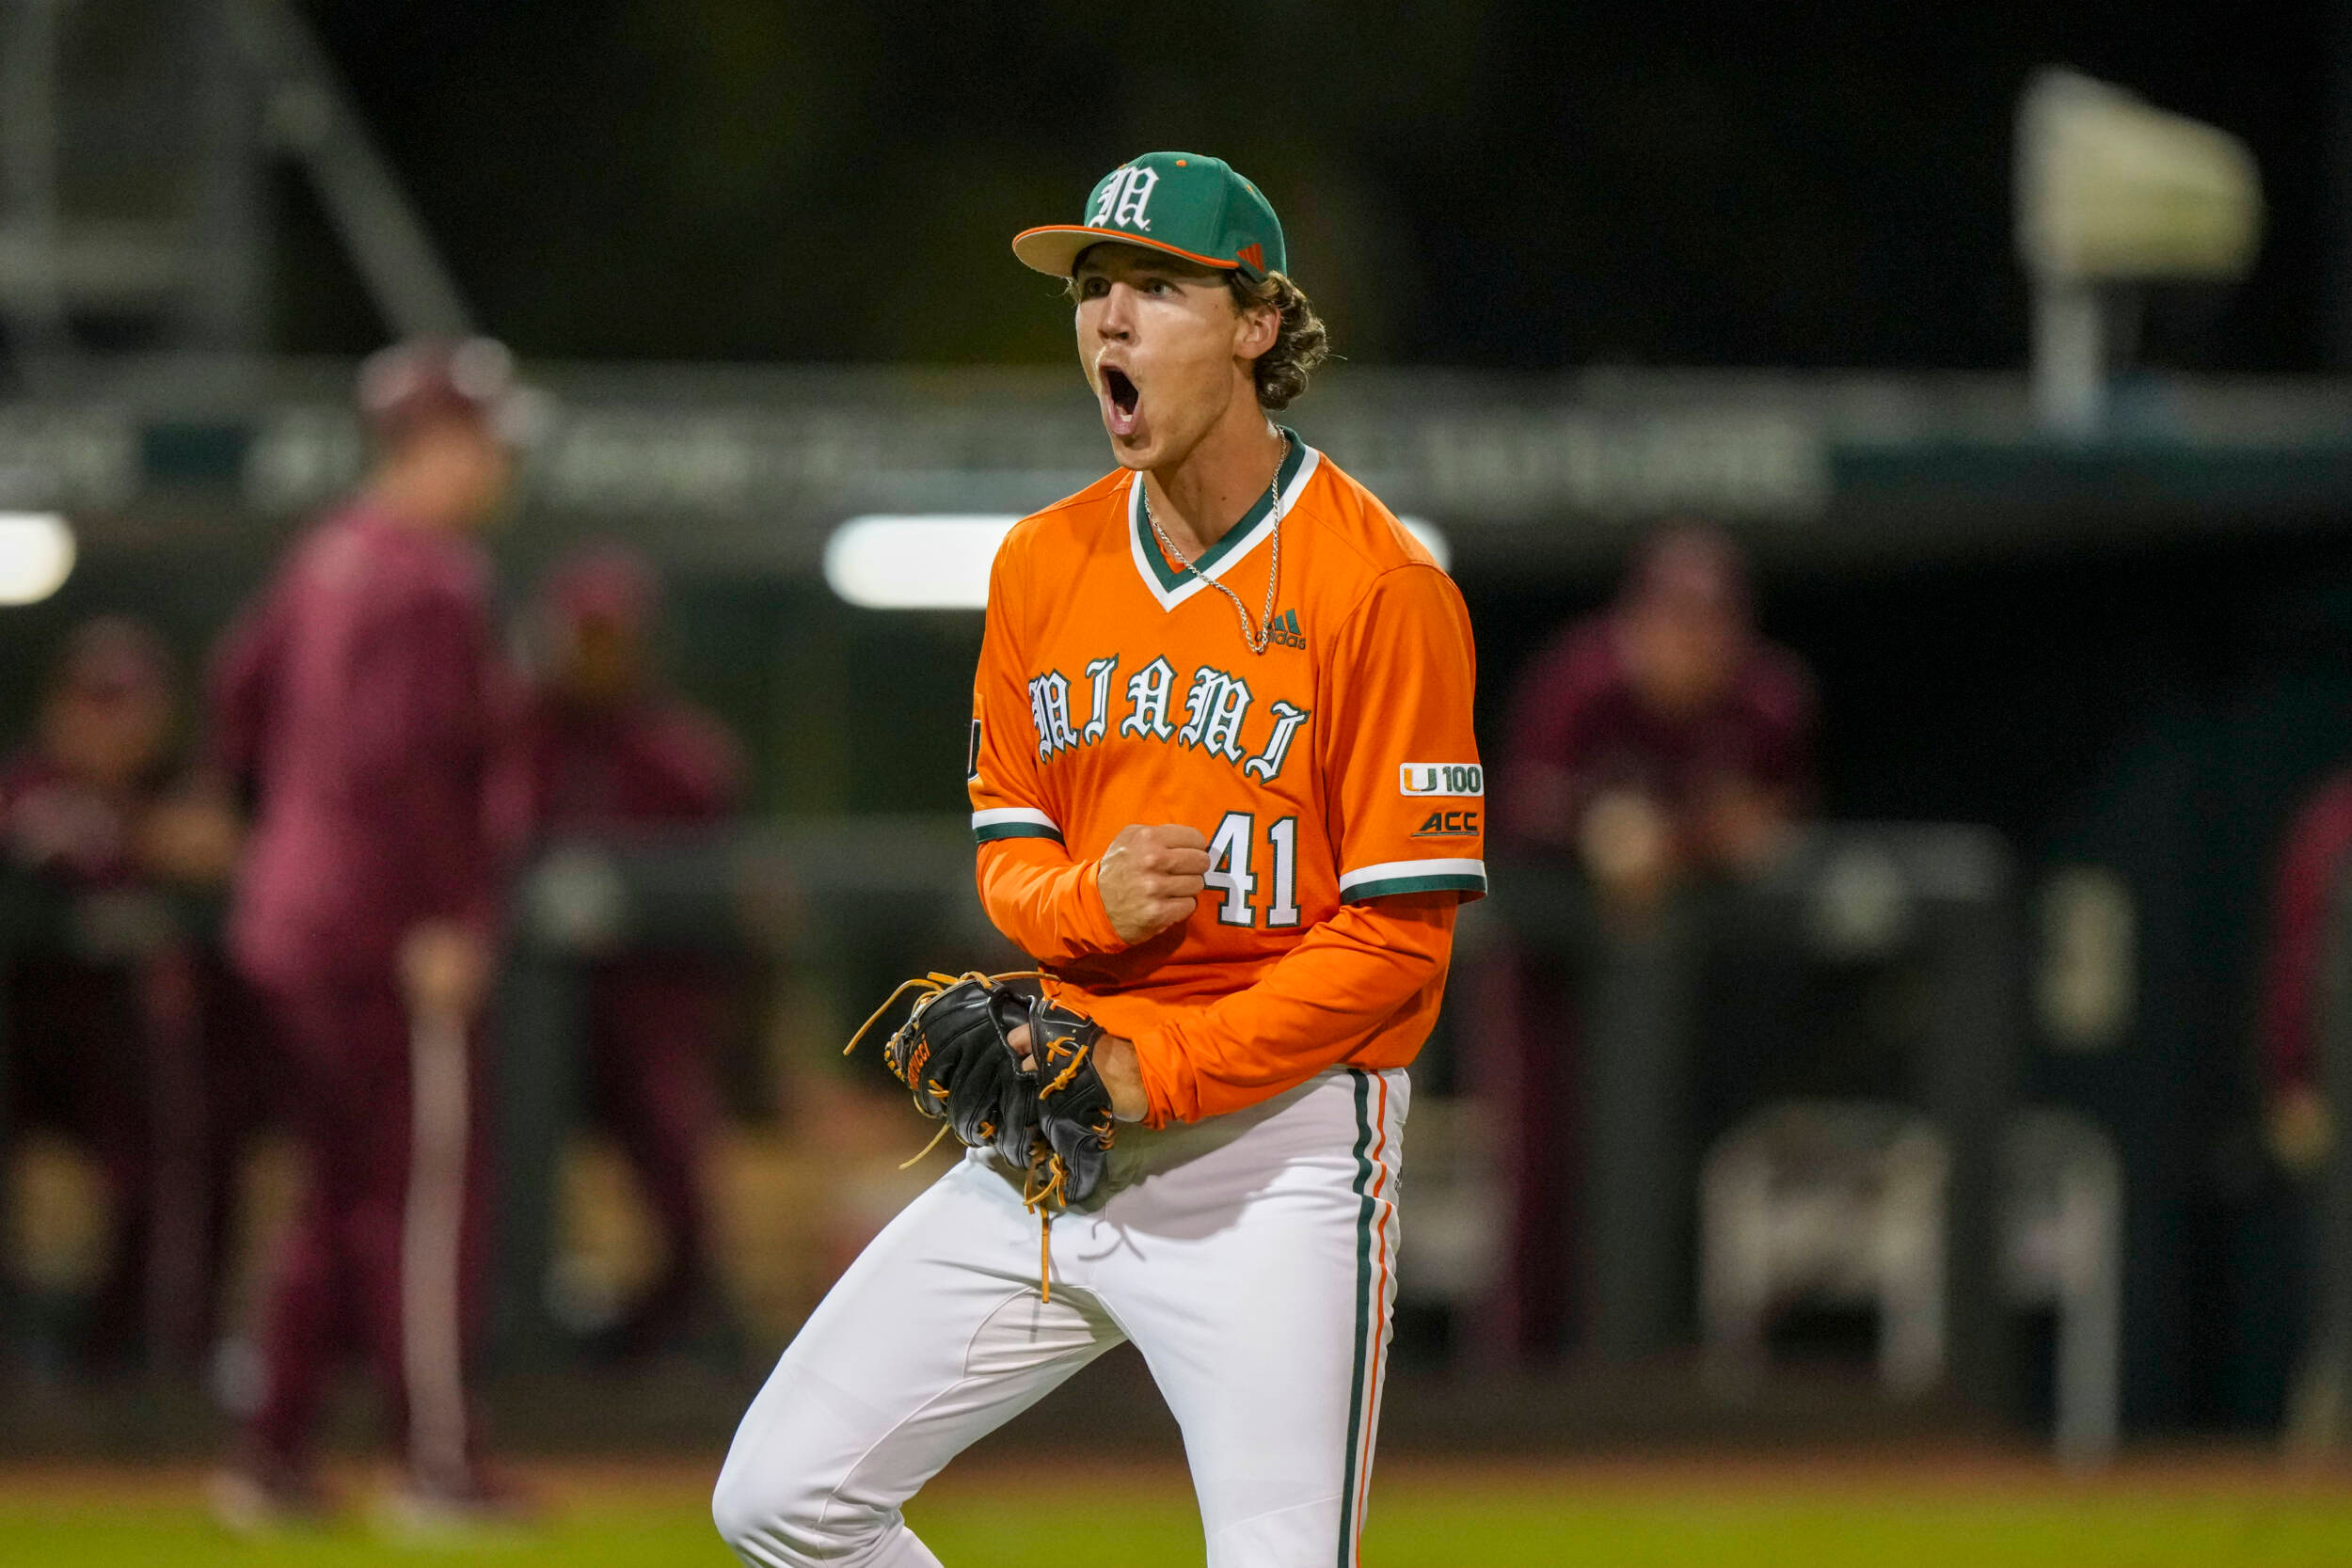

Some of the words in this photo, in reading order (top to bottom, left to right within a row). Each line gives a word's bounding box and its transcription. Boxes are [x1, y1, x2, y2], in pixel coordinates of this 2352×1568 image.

[1029, 653, 1311, 784] MIAMI
[1404, 768, 1438, 792] U
[1442, 766, 1481, 793] 100
[1418, 812, 1479, 832] ACC
[1204, 810, 1301, 928] 41
